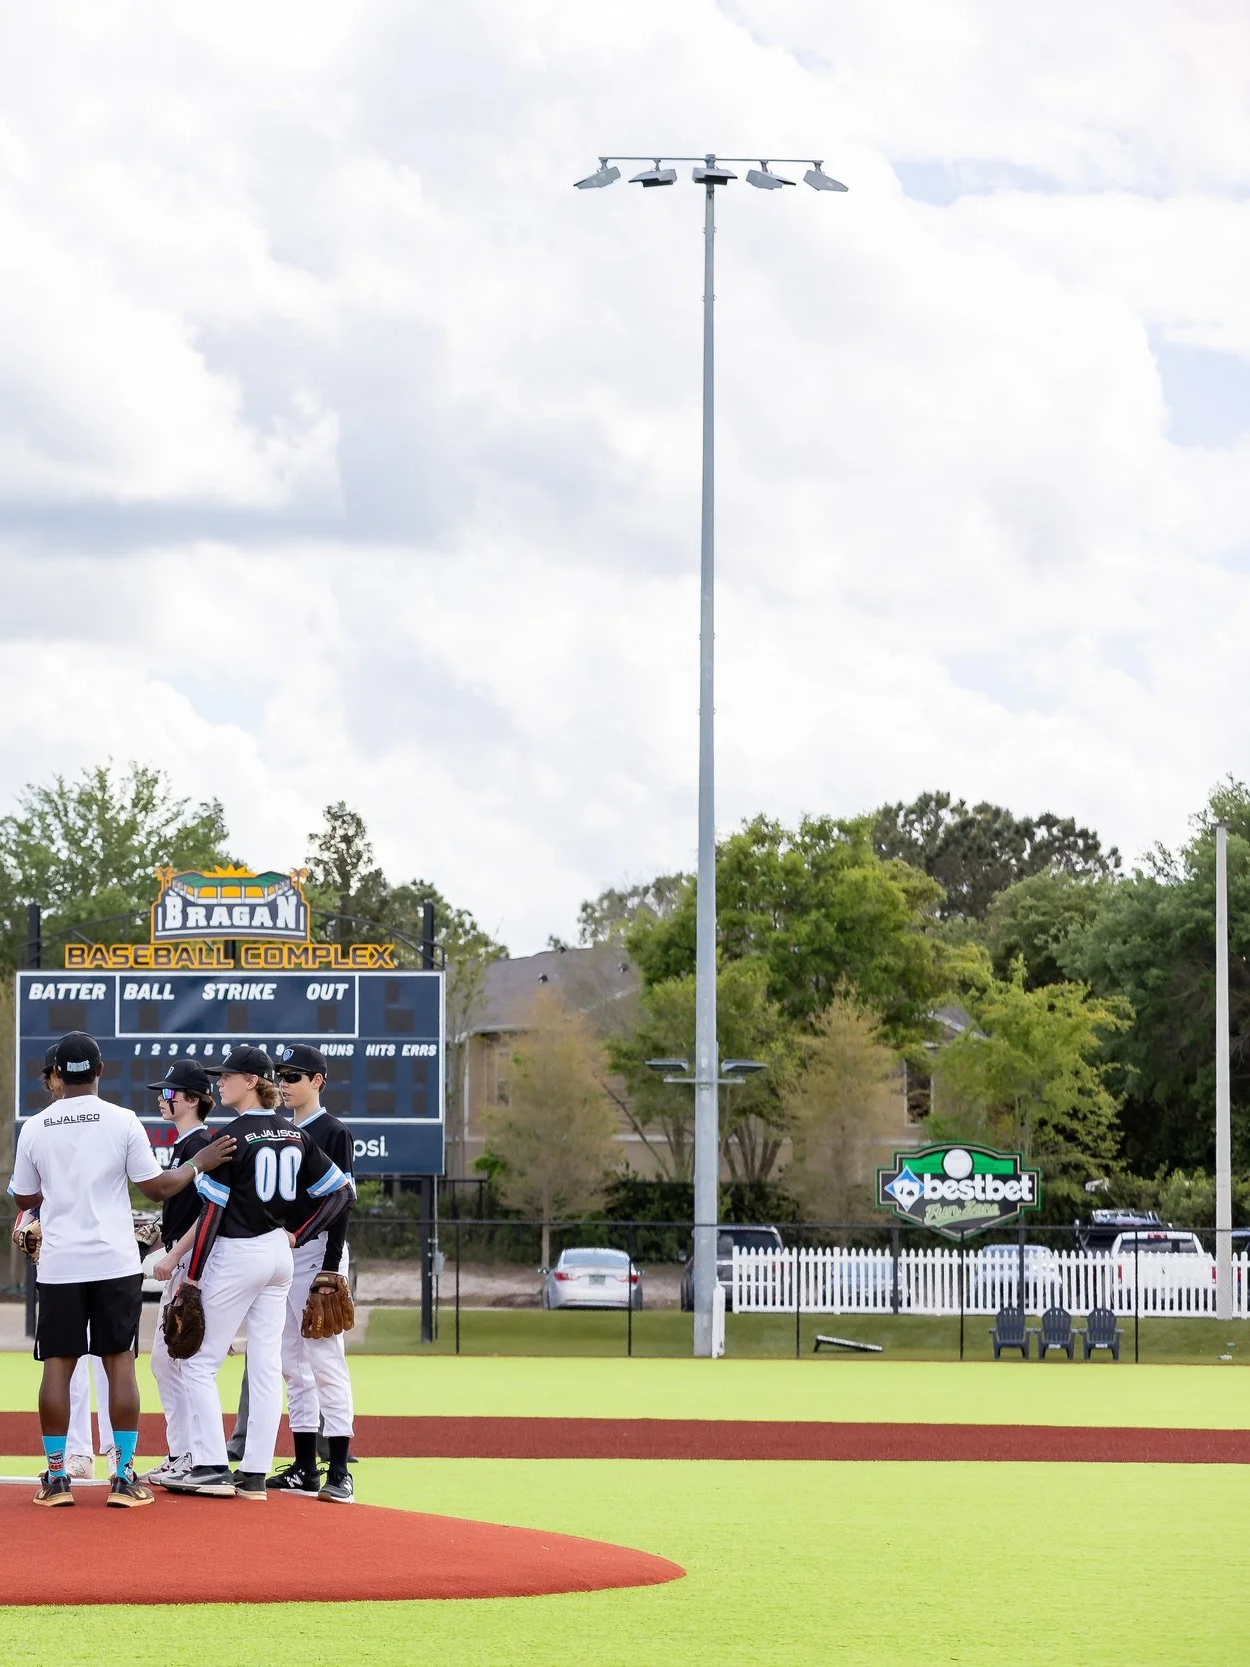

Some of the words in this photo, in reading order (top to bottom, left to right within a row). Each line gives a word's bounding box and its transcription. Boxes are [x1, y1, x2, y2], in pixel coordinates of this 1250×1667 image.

[164, 895, 298, 930] BRAGAN
[65, 944, 235, 969] BASEBALL
[240, 944, 396, 969] COMPLEX
[28, 982, 107, 1001] BATTER
[123, 982, 175, 1001] BALL
[201, 982, 277, 1001] STRIKE
[305, 982, 349, 1001] OUT
[134, 1043, 141, 1056] 1
[150, 1043, 161, 1056] 2
[168, 1043, 179, 1056] 3
[186, 1043, 197, 1056] 4
[203, 1043, 214, 1056] 5
[319, 1043, 355, 1056] RUNS
[365, 1043, 396, 1056] HITS
[401, 1043, 438, 1056] ERRS
[352, 1135, 385, 1162] psi
[254, 1145, 302, 1203] 00
[923, 1173, 1033, 1201] bestbet
[924, 1202, 962, 1224] Fun
